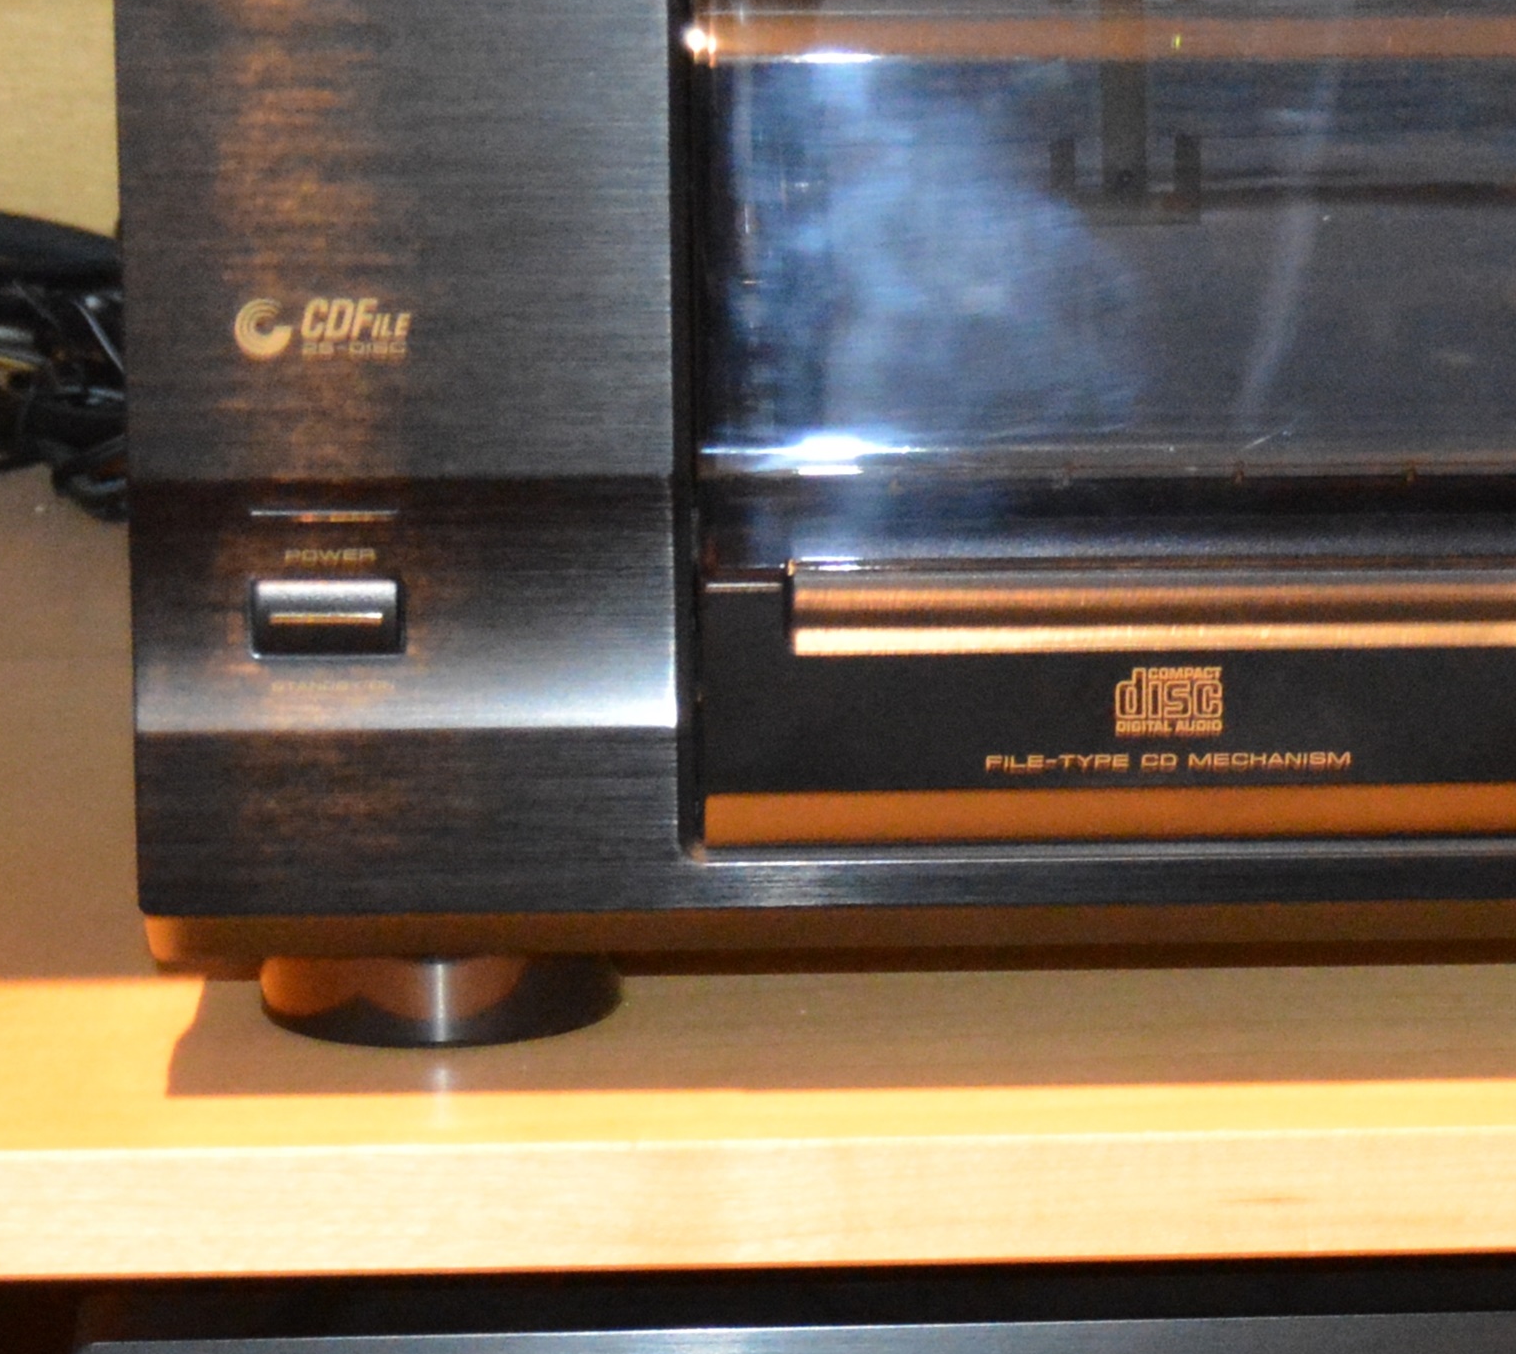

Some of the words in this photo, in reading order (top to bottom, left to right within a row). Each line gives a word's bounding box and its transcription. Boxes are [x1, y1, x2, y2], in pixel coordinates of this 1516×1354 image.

[285, 548, 377, 564] POWER
[1148, 666, 1222, 680] COMPACT
[1116, 720, 1172, 734] DIGITAL
[1176, 719, 1223, 733] AUDIO
[985, 754, 1130, 771] FILE-TYPE
[1141, 754, 1178, 769] CD
[1188, 751, 1352, 768] MECHANISM
